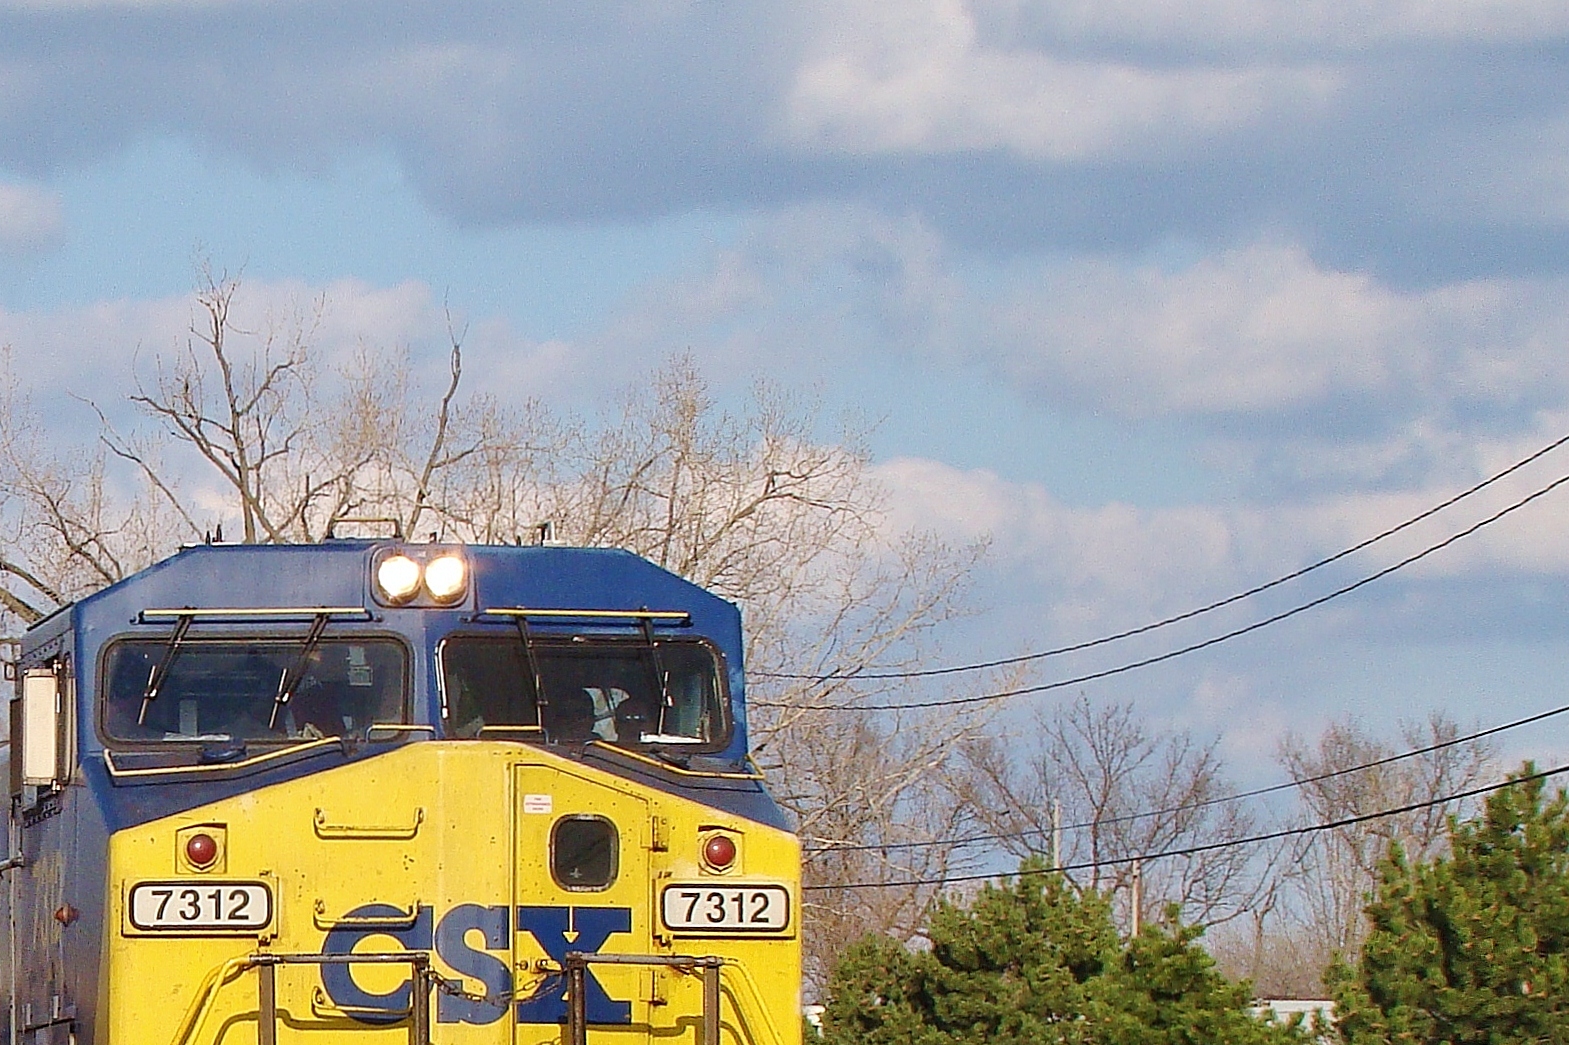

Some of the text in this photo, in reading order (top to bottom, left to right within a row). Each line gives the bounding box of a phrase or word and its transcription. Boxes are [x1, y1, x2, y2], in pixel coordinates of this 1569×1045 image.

[151, 889, 250, 921] 7312
[681, 891, 770, 923] 7312
[320, 902, 632, 1026] CSX
